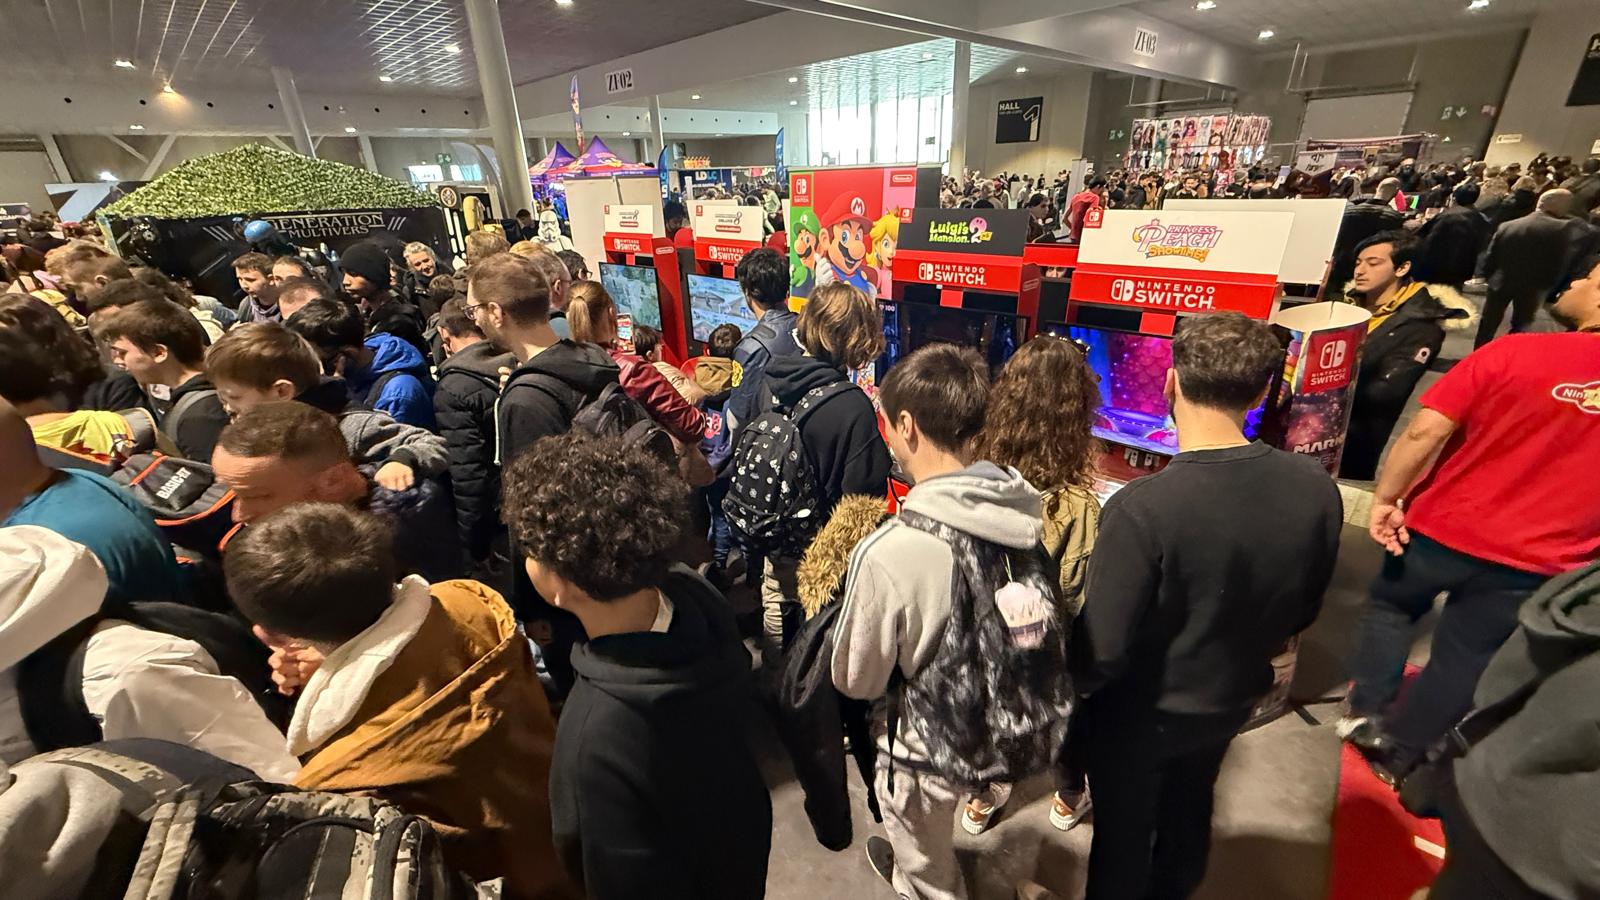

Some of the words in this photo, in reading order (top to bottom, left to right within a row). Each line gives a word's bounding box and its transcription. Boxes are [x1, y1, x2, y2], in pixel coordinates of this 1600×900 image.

[1134, 30, 1157, 54] ZF03
[606, 70, 632, 91] ZF02
[1000, 102, 1020, 111] HALL
[695, 171, 717, 181] LDLC
[289, 225, 369, 238] MULTIVERS
[929, 220, 969, 236] Luigi's
[1167, 225, 1218, 234] PRINCESS
[1133, 219, 1223, 252] PEACH
[619, 243, 641, 251] SWITCH
[717, 246, 744, 254] NINTENDO
[1146, 245, 1209, 262] SHOWTIME!
[935, 263, 986, 274] NINTENDO
[934, 271, 984, 285] SWITCH
[1137, 280, 1216, 295] NINTENDO
[1134, 289, 1214, 310] SWITCH
[1310, 373, 1346, 386] SWITCH
